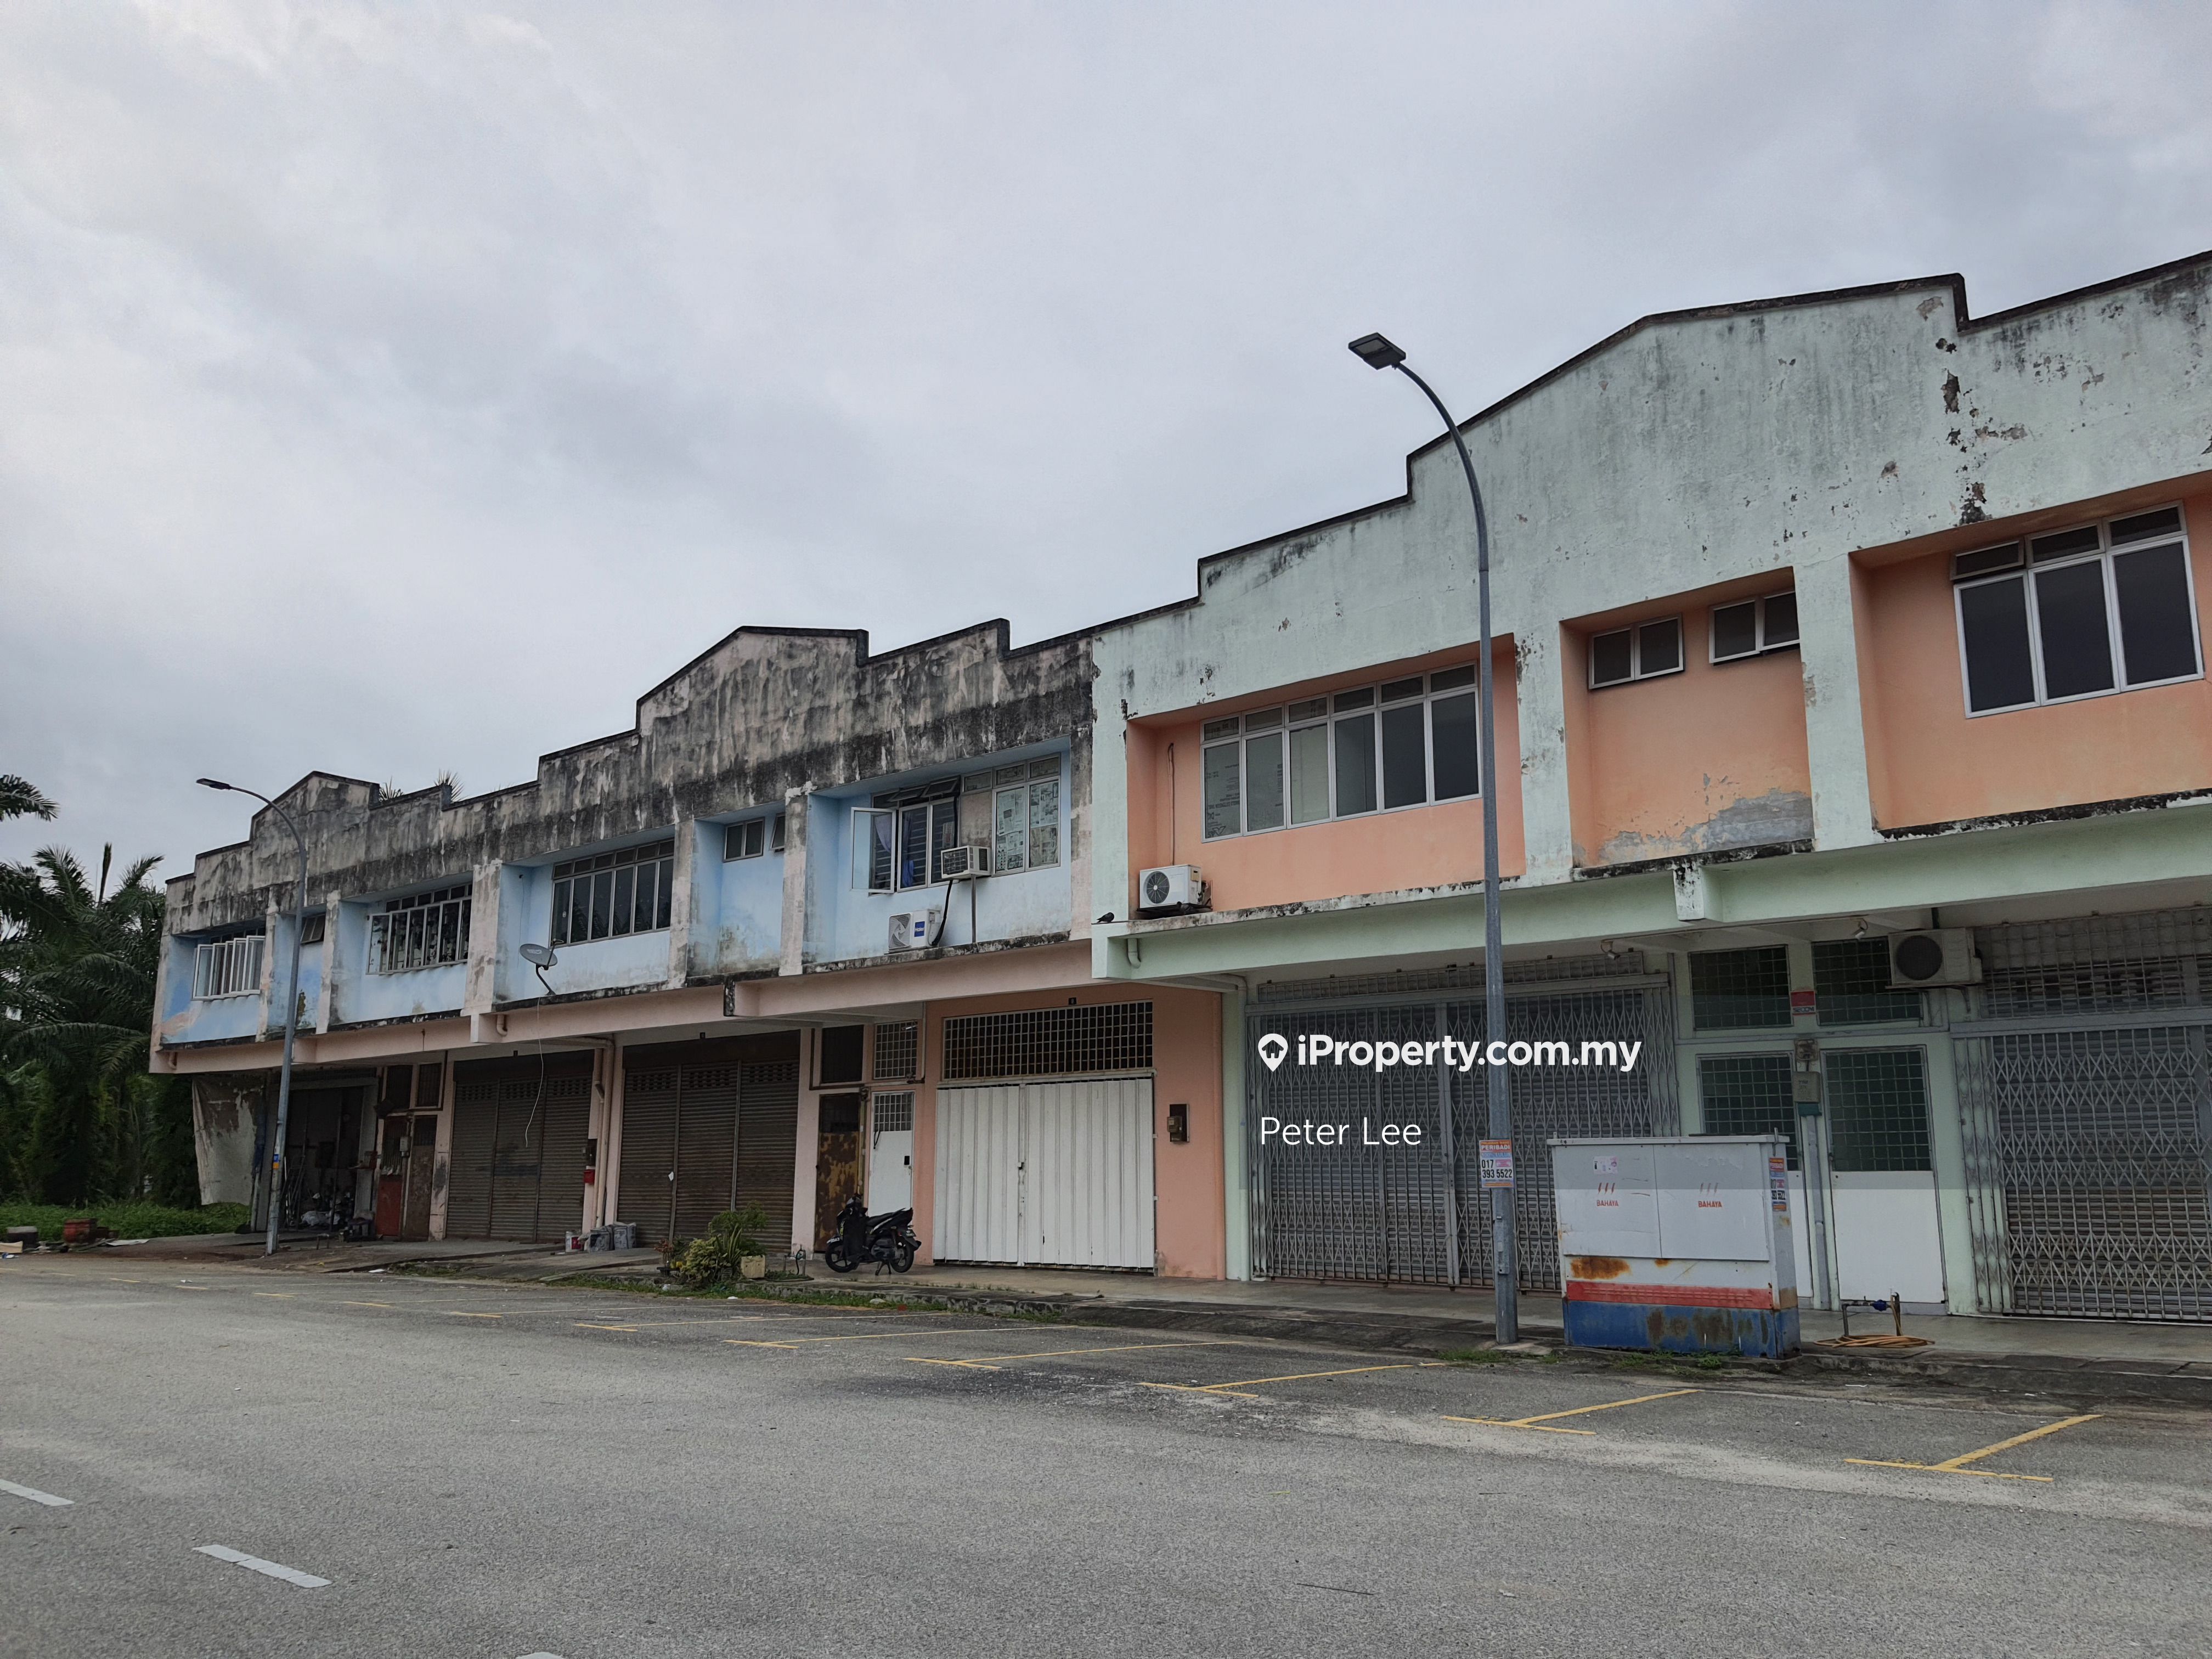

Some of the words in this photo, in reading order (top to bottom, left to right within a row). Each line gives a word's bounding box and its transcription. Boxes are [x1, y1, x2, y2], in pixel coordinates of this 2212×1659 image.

[1481, 1159, 1494, 1169] 017
[1482, 1169, 1494, 1178] 393
[1496, 1169, 1513, 1178] 5522
